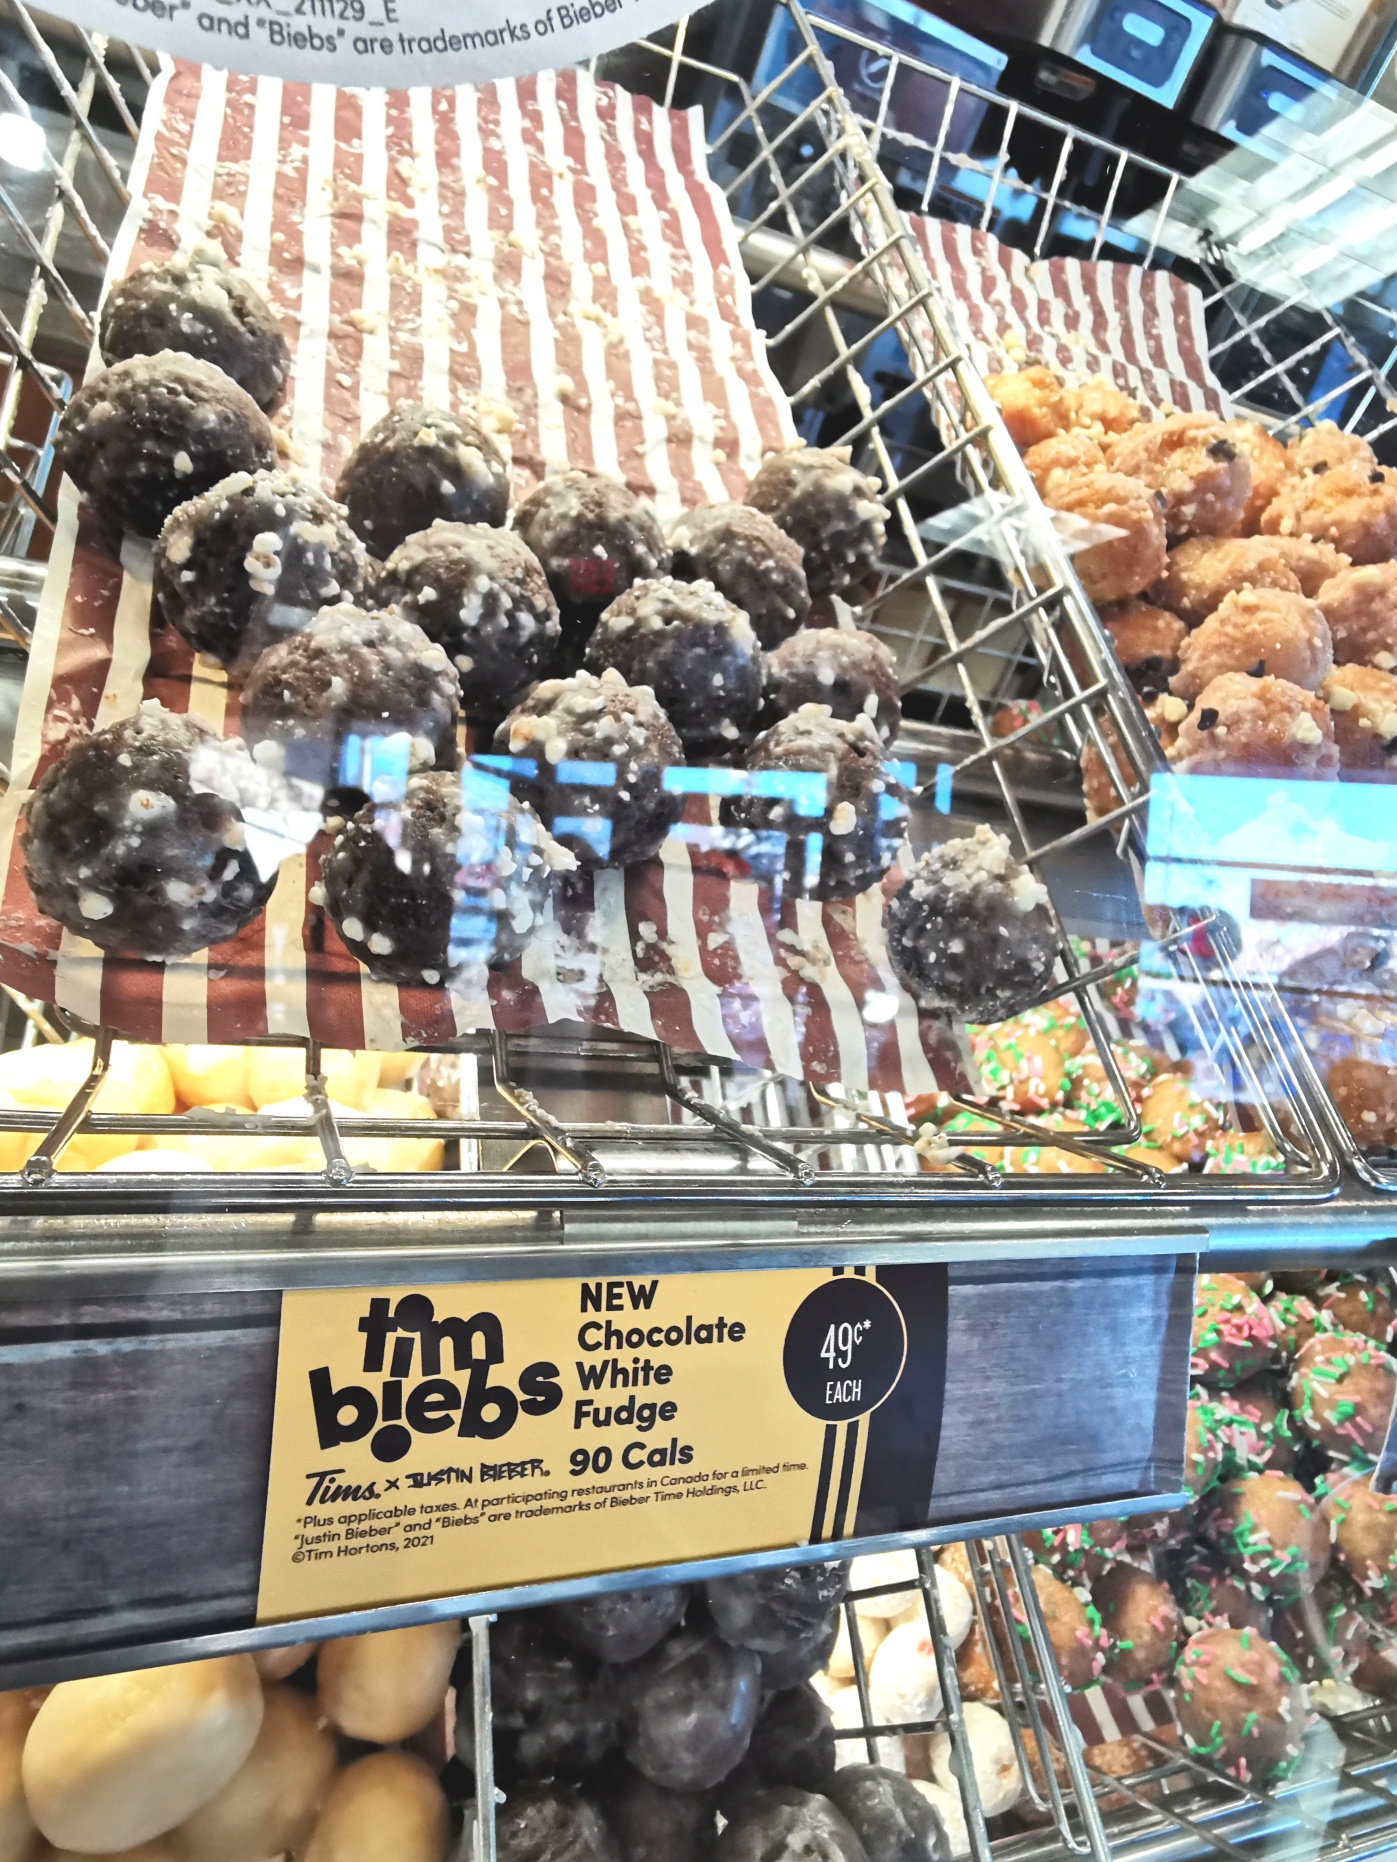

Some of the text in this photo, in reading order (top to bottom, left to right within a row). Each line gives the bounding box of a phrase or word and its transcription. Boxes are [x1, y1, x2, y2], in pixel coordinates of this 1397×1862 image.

[197, 13, 250, 40] and
[353, 36, 394, 55] are
[398, 19, 531, 54] trademarks
[534, 9, 555, 36] of
[580, 1280, 659, 1312] NEW
[358, 1294, 504, 1378] tim
[577, 1315, 746, 1351] Chocolate
[575, 1357, 673, 1391] White
[825, 1379, 862, 1404] EACH
[573, 1395, 678, 1432] Fudge
[569, 1438, 695, 1477] 90 Cals
[337, 1504, 417, 1527] applicable
[419, 1502, 460, 1515] taxes.
[463, 1498, 479, 1510] At
[481, 1488, 568, 1511] participating
[571, 1479, 644, 1496] restaurants
[646, 1477, 658, 1488] in
[660, 1472, 709, 1487] Canada
[712, 1469, 729, 1481] for
[731, 1469, 739, 1479] a
[741, 1463, 780, 1477] limited
[782, 1461, 809, 1473] time.
[405, 1466, 473, 1489] JUSTIN
[403, 1519, 432, 1533] and
[487, 1511, 511, 1522] are
[515, 1500, 591, 1520] trademarks
[594, 1498, 607, 1511] of
[609, 1493, 651, 1509] Bieber
[653, 1490, 684, 1502] Time
[686, 1484, 741, 1499] Holdings,
[743, 1479, 767, 1493] LLC.
[337, 1541, 400, 1558] Hortons,
[403, 1535, 434, 1549] 2021
